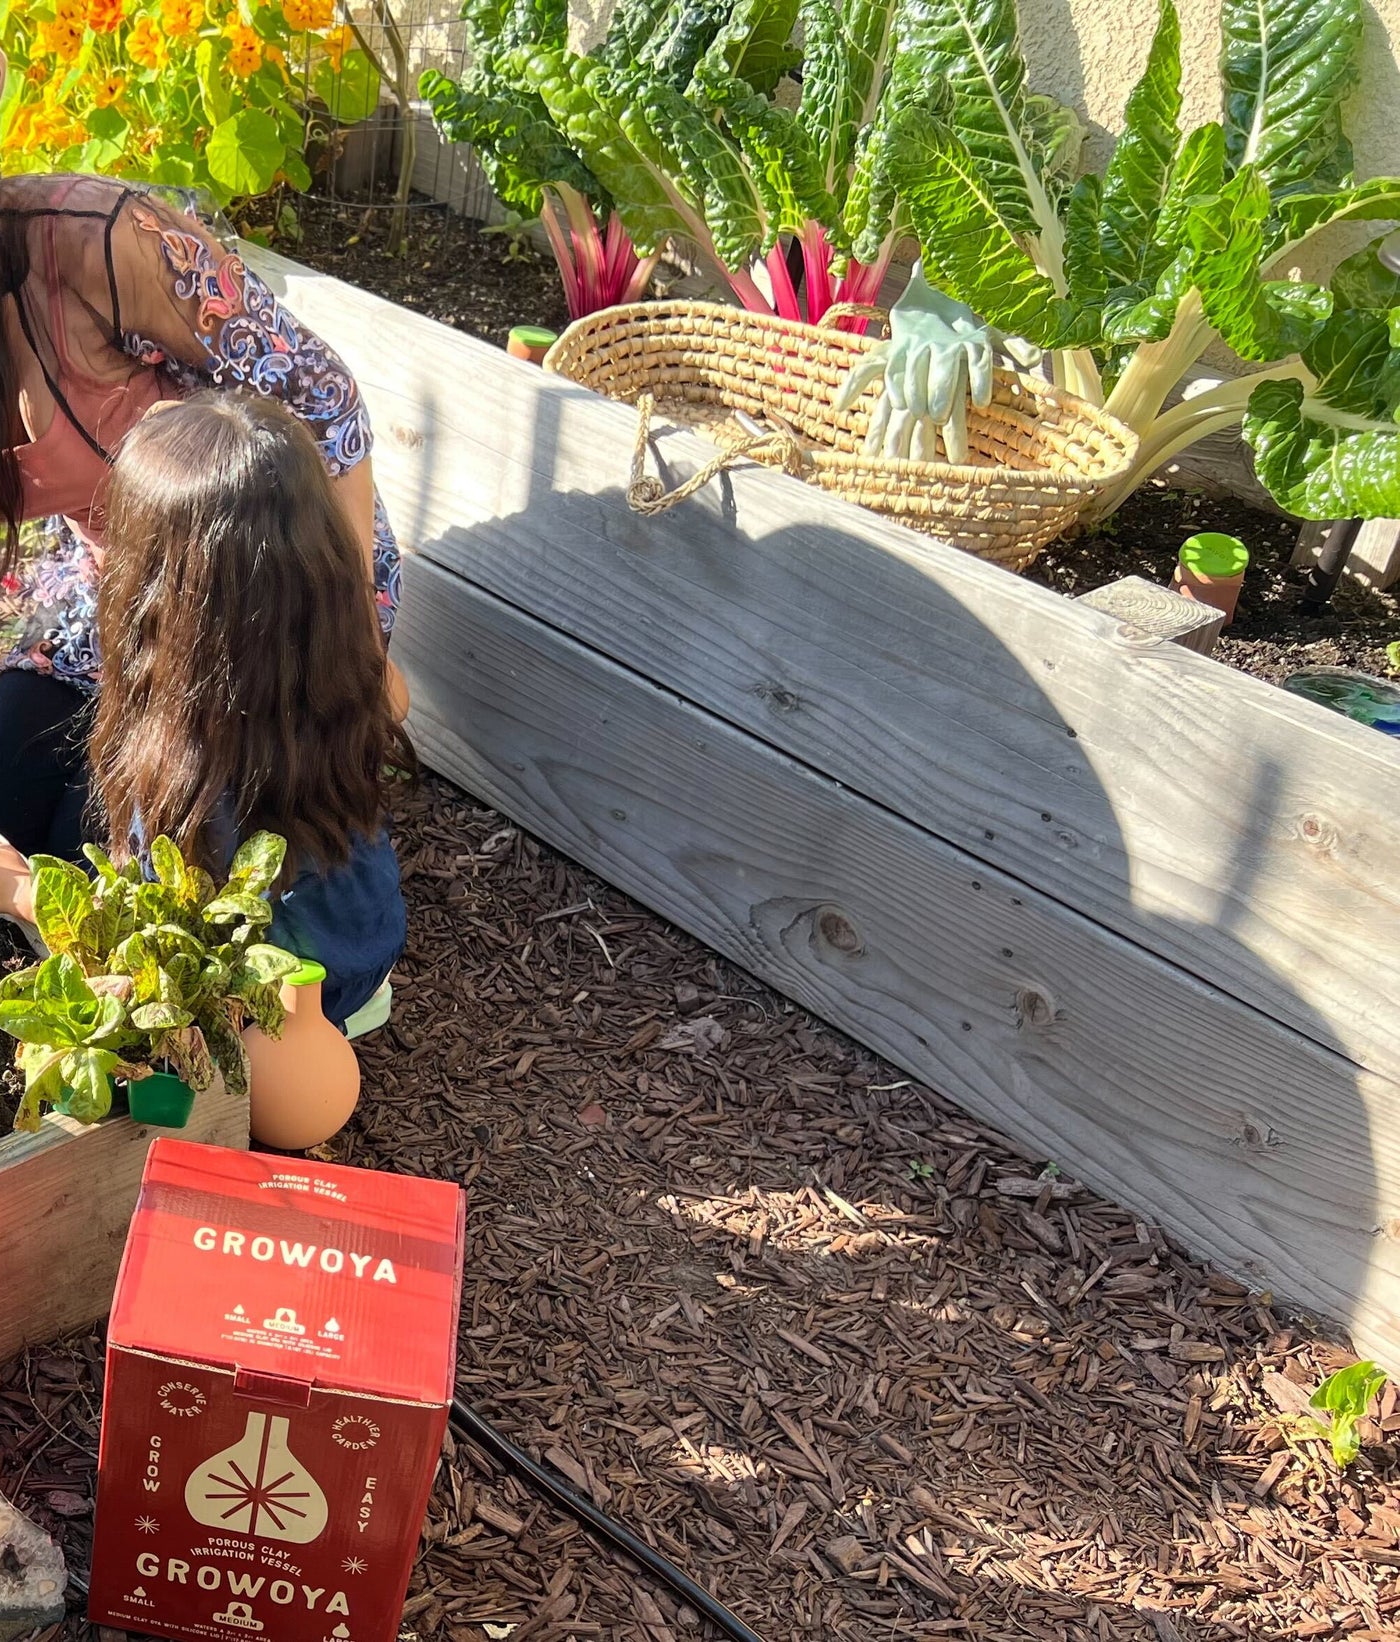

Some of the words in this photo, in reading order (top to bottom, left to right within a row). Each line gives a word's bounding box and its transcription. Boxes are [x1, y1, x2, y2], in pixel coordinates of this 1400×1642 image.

[258, 1182, 310, 1191] IRRIGATION
[313, 1187, 347, 1202] VESSEL
[314, 1179, 337, 1189] CLAY
[193, 1227, 397, 1284] GROWOYA
[224, 1313, 251, 1324] SMALL
[268, 1321, 301, 1333] MEDIUM
[317, 1330, 345, 1342] LARGE
[157, 1381, 207, 1405] CONSERVE
[160, 1399, 202, 1417] WATER
[332, 1415, 380, 1438] HEALTHIER
[331, 1433, 377, 1450] GARDEN
[143, 1435, 162, 1492] GROW
[357, 1477, 377, 1533] EASY
[207, 1537, 255, 1550] POROUS
[261, 1546, 291, 1560] CLAY
[190, 1547, 255, 1561] IRRIGATION
[261, 1556, 302, 1577] VESSEL
[136, 1552, 350, 1616] GROWOYA
[123, 1595, 156, 1607] SMALL
[107, 1610, 131, 1619] MEDIUM
[219, 1615, 258, 1629] MEDIUM
